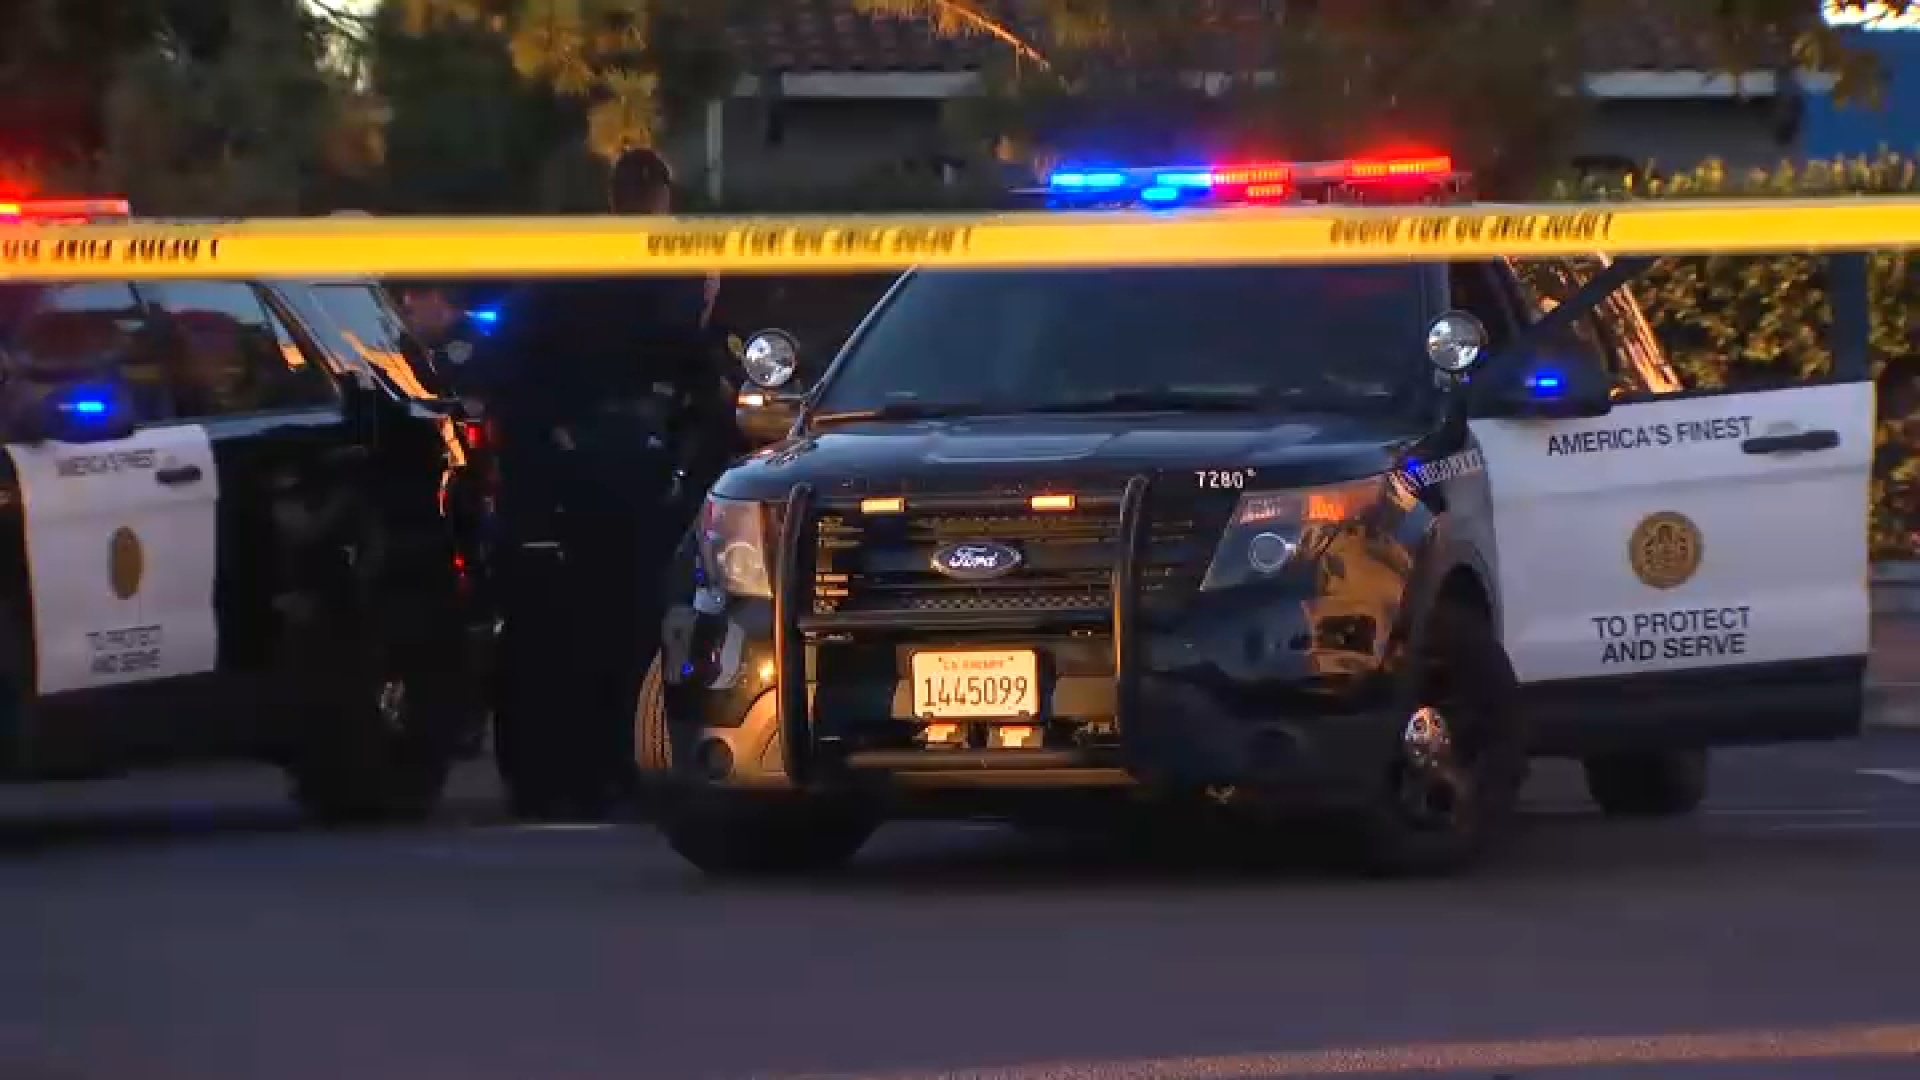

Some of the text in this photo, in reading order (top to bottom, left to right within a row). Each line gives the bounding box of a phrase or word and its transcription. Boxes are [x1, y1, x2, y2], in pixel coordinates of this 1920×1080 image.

[1547, 415, 1752, 456] AMERICA'S FINEST
[948, 547, 998, 568] Ford
[1591, 606, 1750, 639] TO PROTECT
[1602, 633, 1745, 664] AND SERVE
[923, 676, 1028, 707] 1445099
